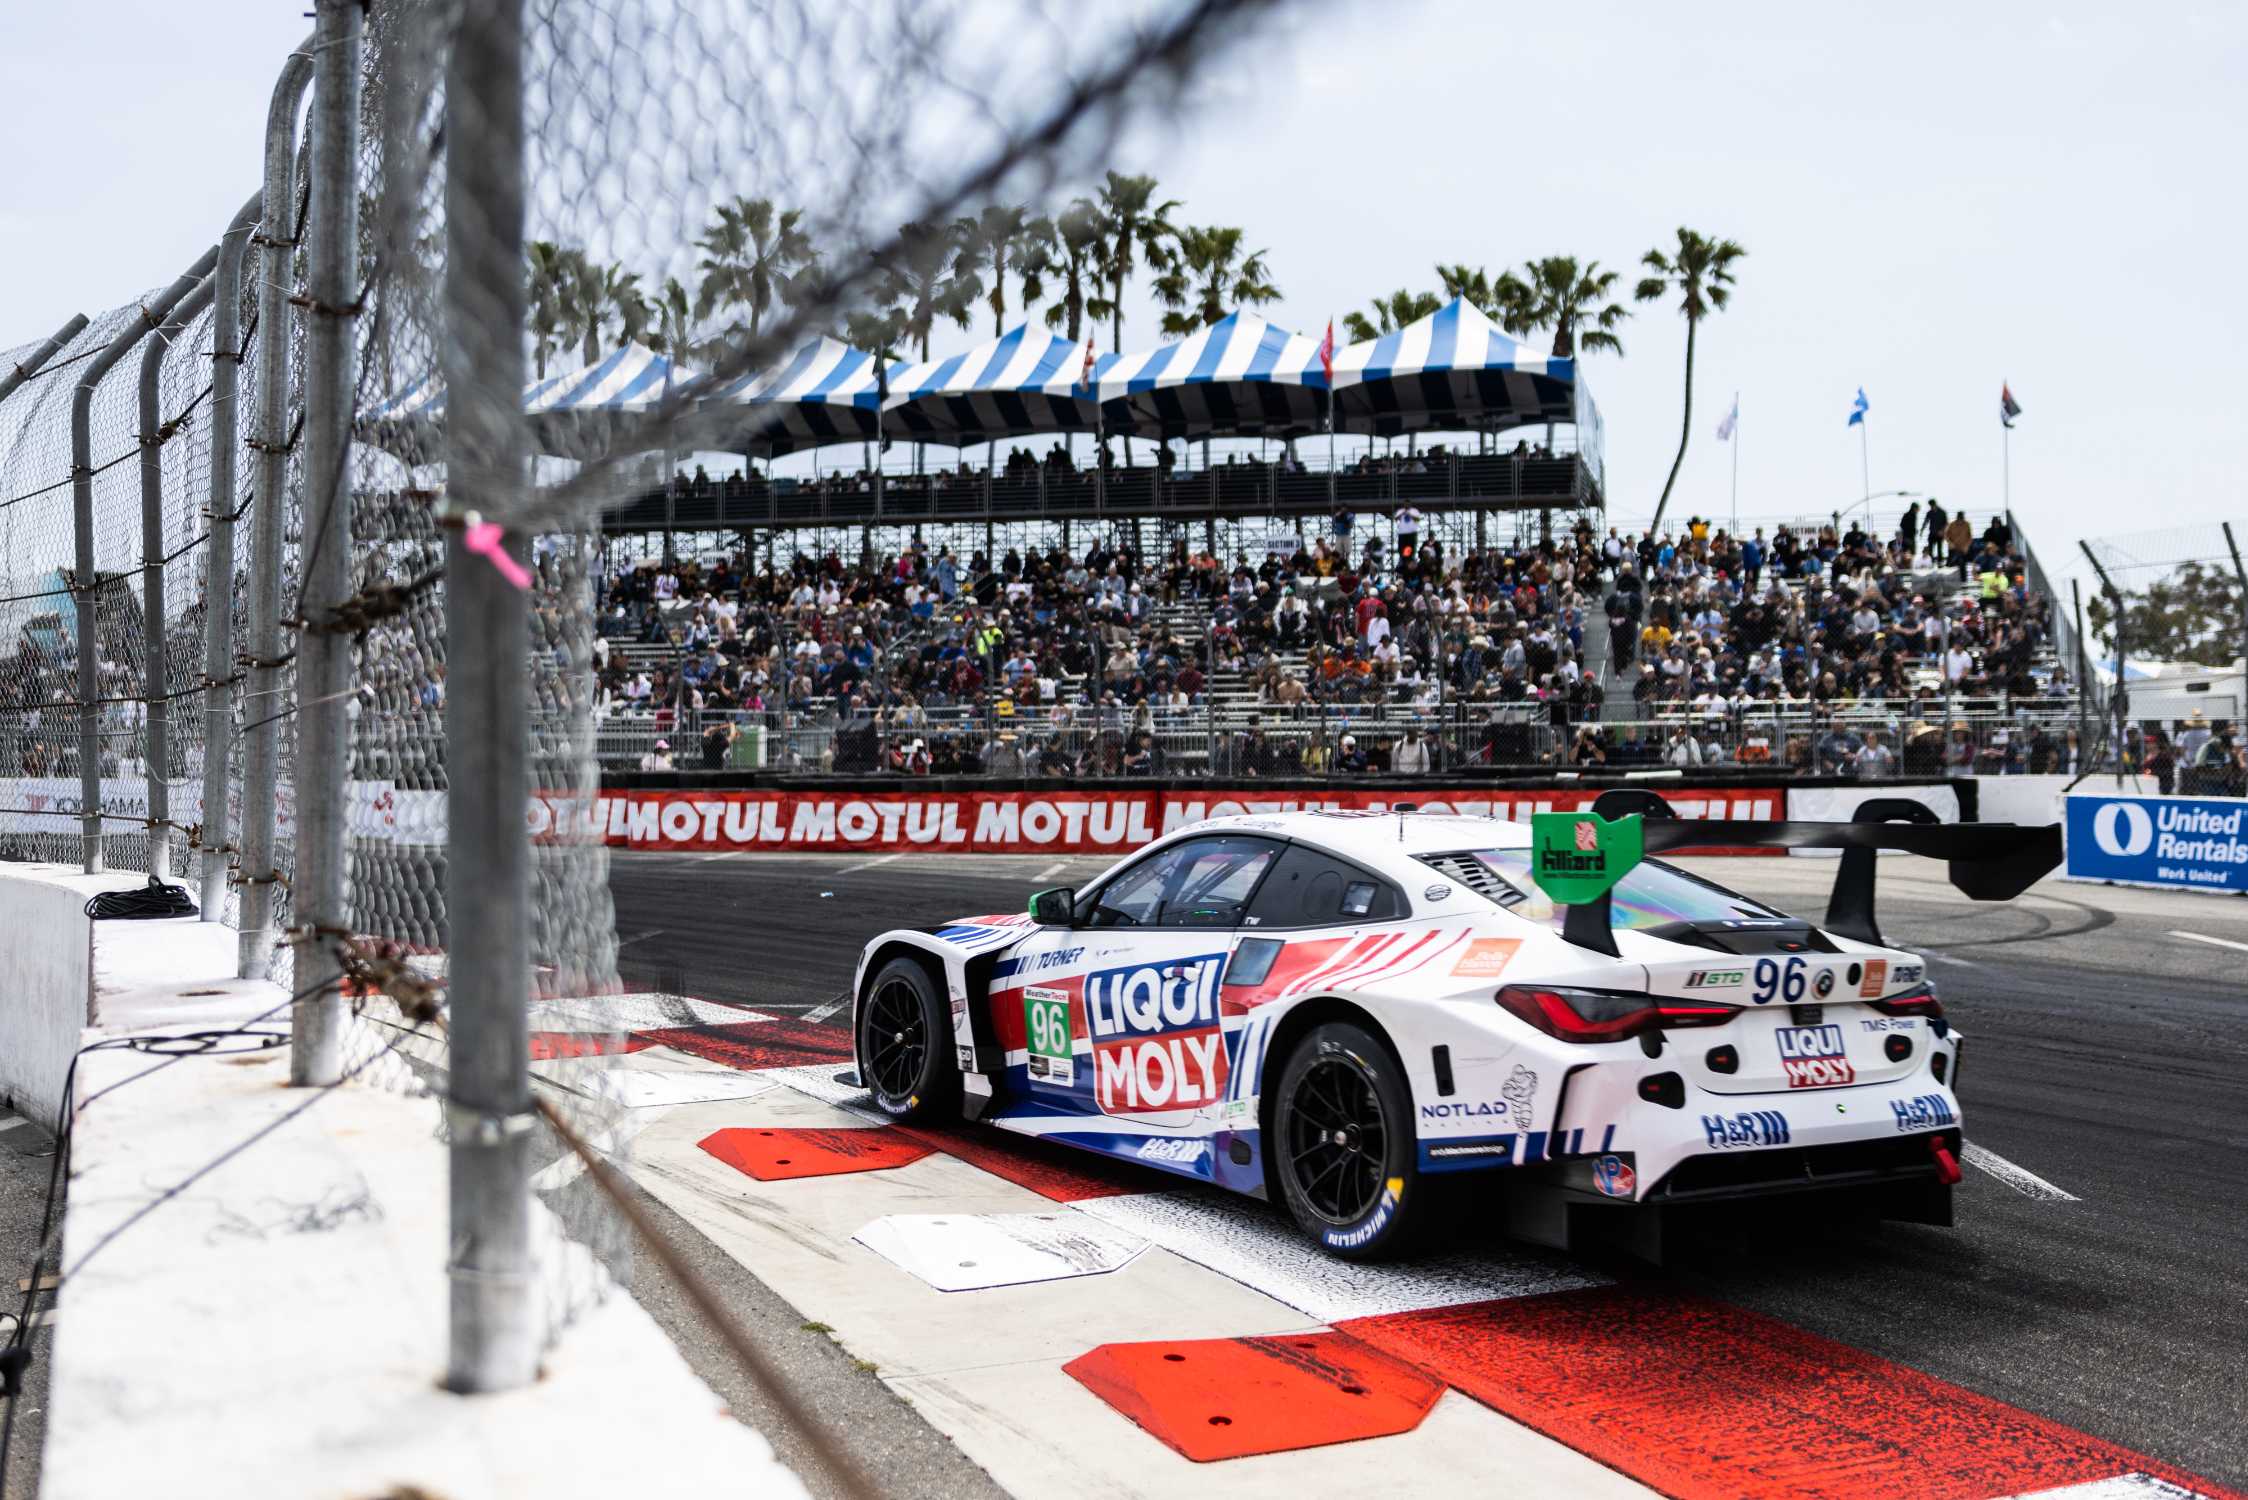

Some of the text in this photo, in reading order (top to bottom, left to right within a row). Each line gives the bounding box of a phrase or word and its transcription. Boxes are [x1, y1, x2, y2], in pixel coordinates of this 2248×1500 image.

[525, 798, 629, 836] OTUL
[628, 801, 786, 842] MOTUL
[789, 801, 967, 842] MOTUL
[973, 800, 1154, 844] MOTUL
[2157, 805, 2242, 835] United
[2157, 833, 2248, 864] Rentals
[2157, 866, 2228, 884] Work United
[1090, 958, 1221, 1037] LIQUI
[1707, 972, 1744, 985] GTD
[1752, 957, 1807, 1004] 96
[1031, 1002, 1066, 1054] 96
[1777, 1027, 1844, 1057] LIQUI
[1859, 1019, 1887, 1032] TMS
[1100, 1033, 1220, 1109] MOLY
[1784, 1059, 1851, 1086] MOLY
[1421, 1102, 1508, 1118] NOTLAD
[1327, 1207, 1387, 1247] MICHELIN
